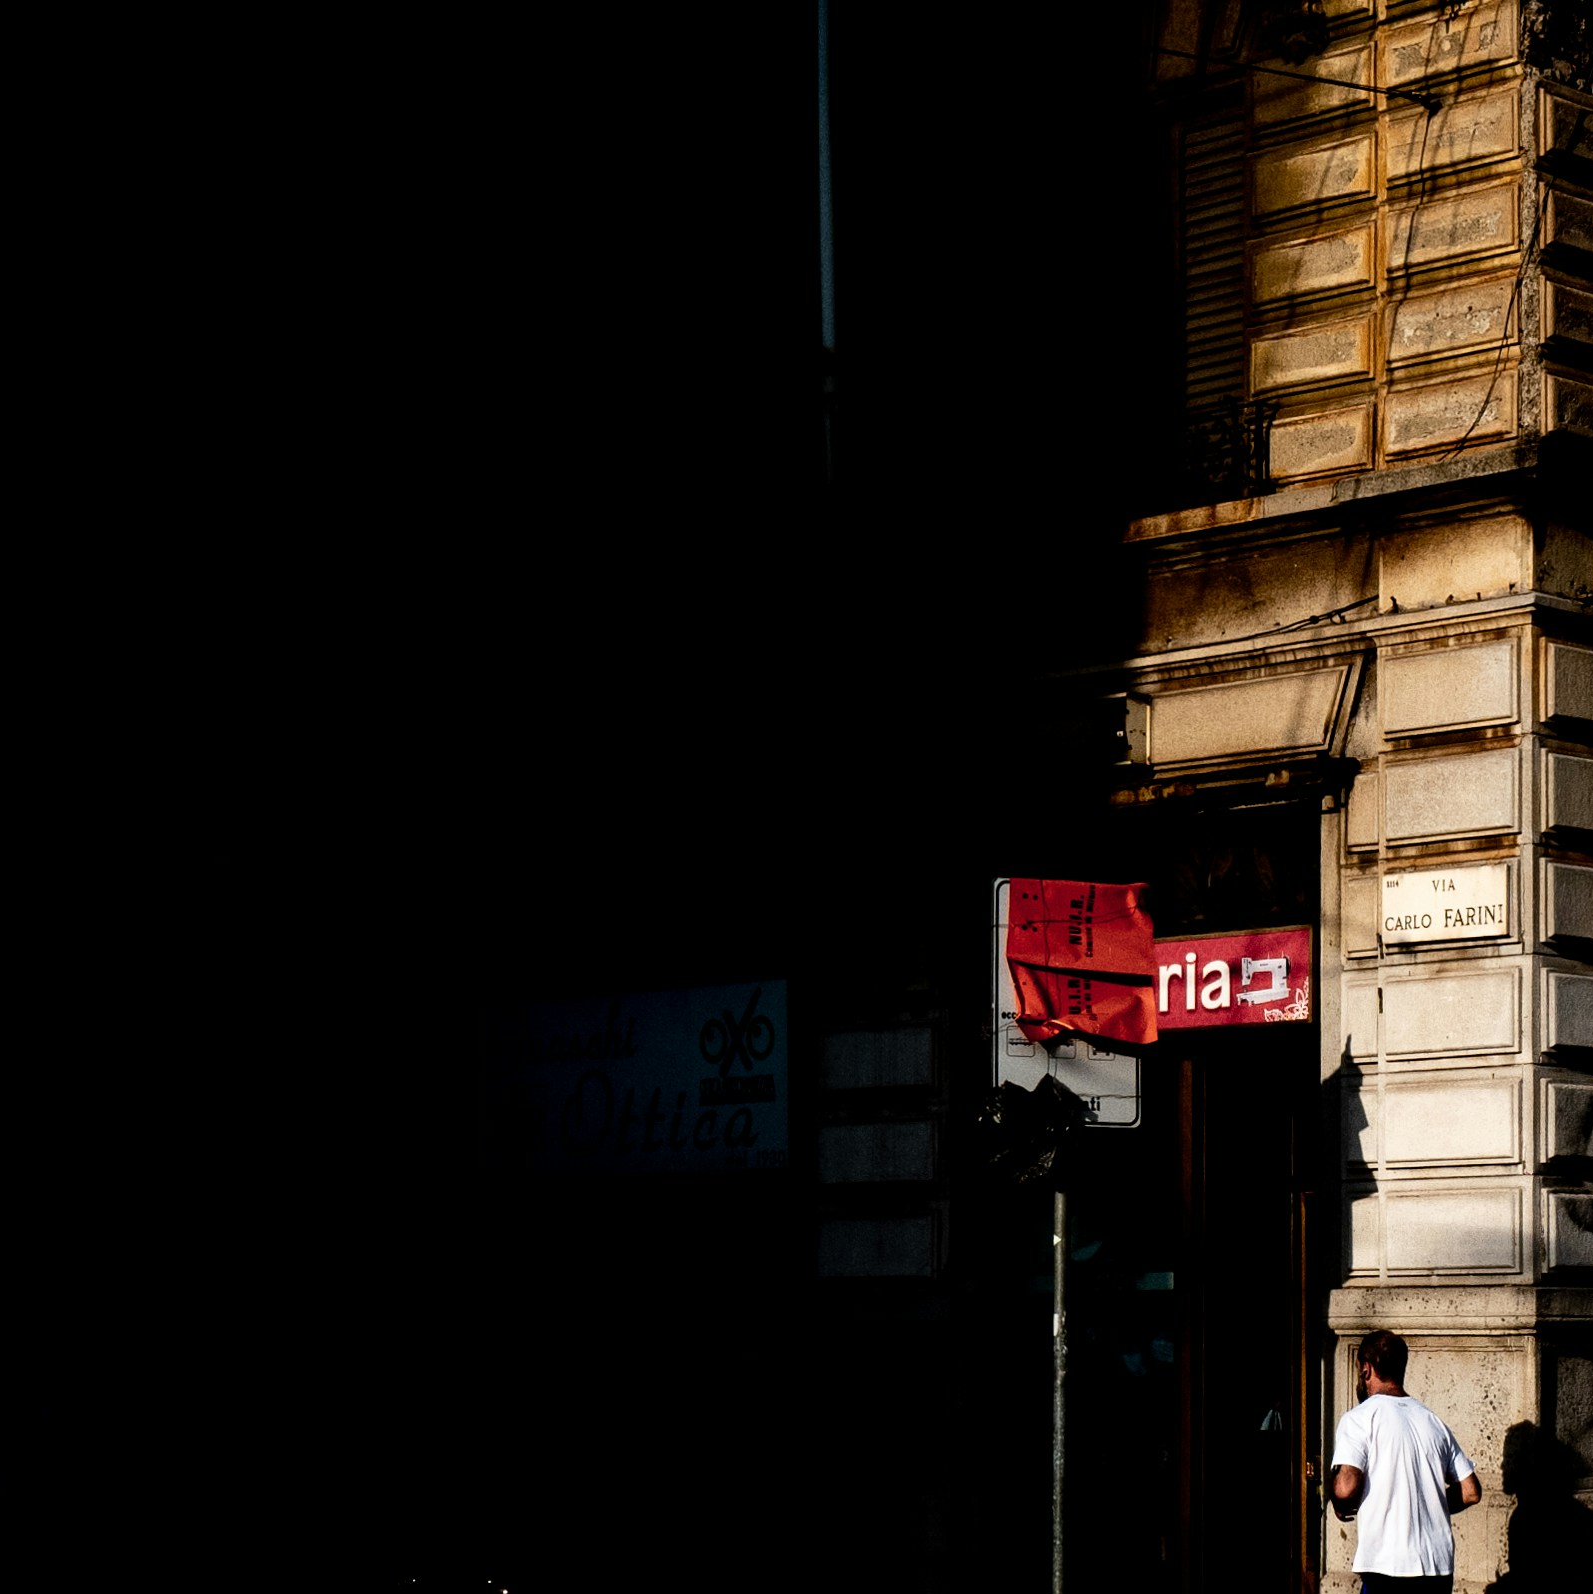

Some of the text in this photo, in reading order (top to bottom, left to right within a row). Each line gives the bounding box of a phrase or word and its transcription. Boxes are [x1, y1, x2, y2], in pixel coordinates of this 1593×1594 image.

[1431, 878, 1456, 892] VIA
[1384, 903, 1504, 931] CARLO FARINI
[1158, 951, 1231, 1014] ria
[561, 1070, 760, 1154] Ottica
